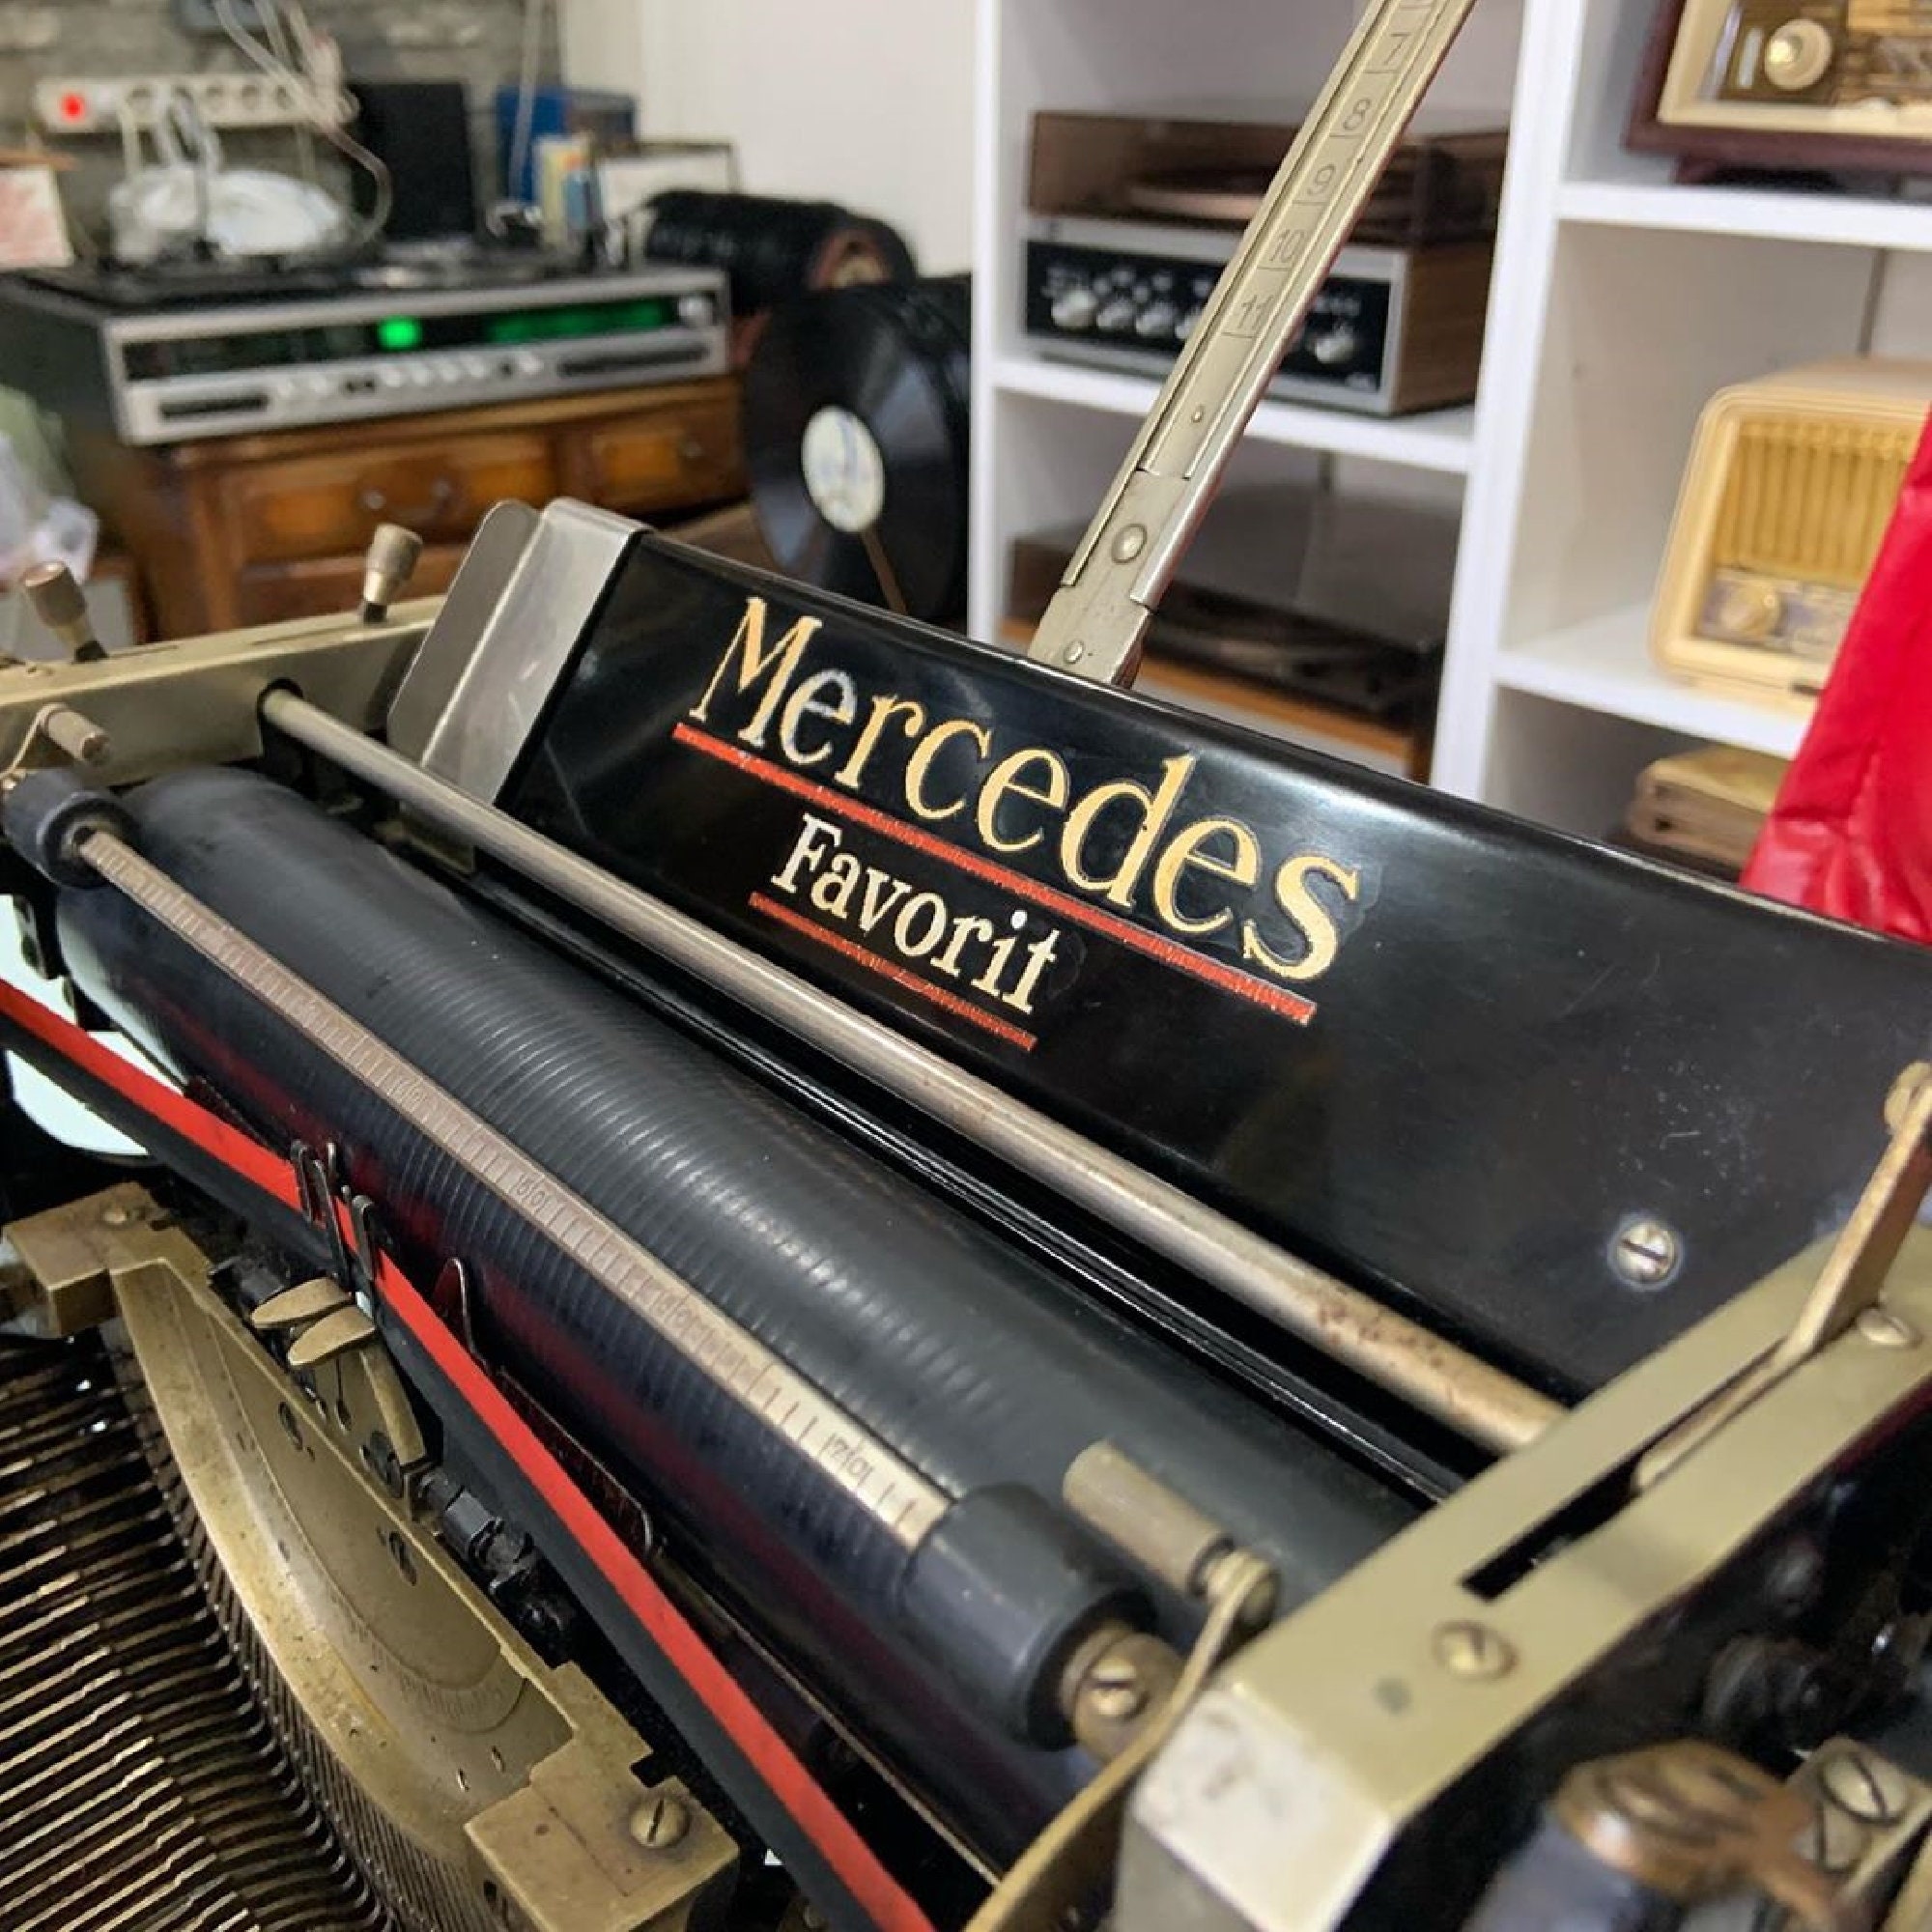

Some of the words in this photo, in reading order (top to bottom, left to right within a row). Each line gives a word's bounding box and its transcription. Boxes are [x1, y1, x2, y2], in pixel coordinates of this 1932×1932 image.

[1384, 32, 1411, 66] 7
[1342, 99, 1371, 130] 8
[1308, 164, 1336, 194] 9
[1269, 229, 1304, 264] 10
[1237, 295, 1274, 330] 11
[689, 596, 1359, 980] Mercedes
[770, 812, 1060, 1015] Favorit
